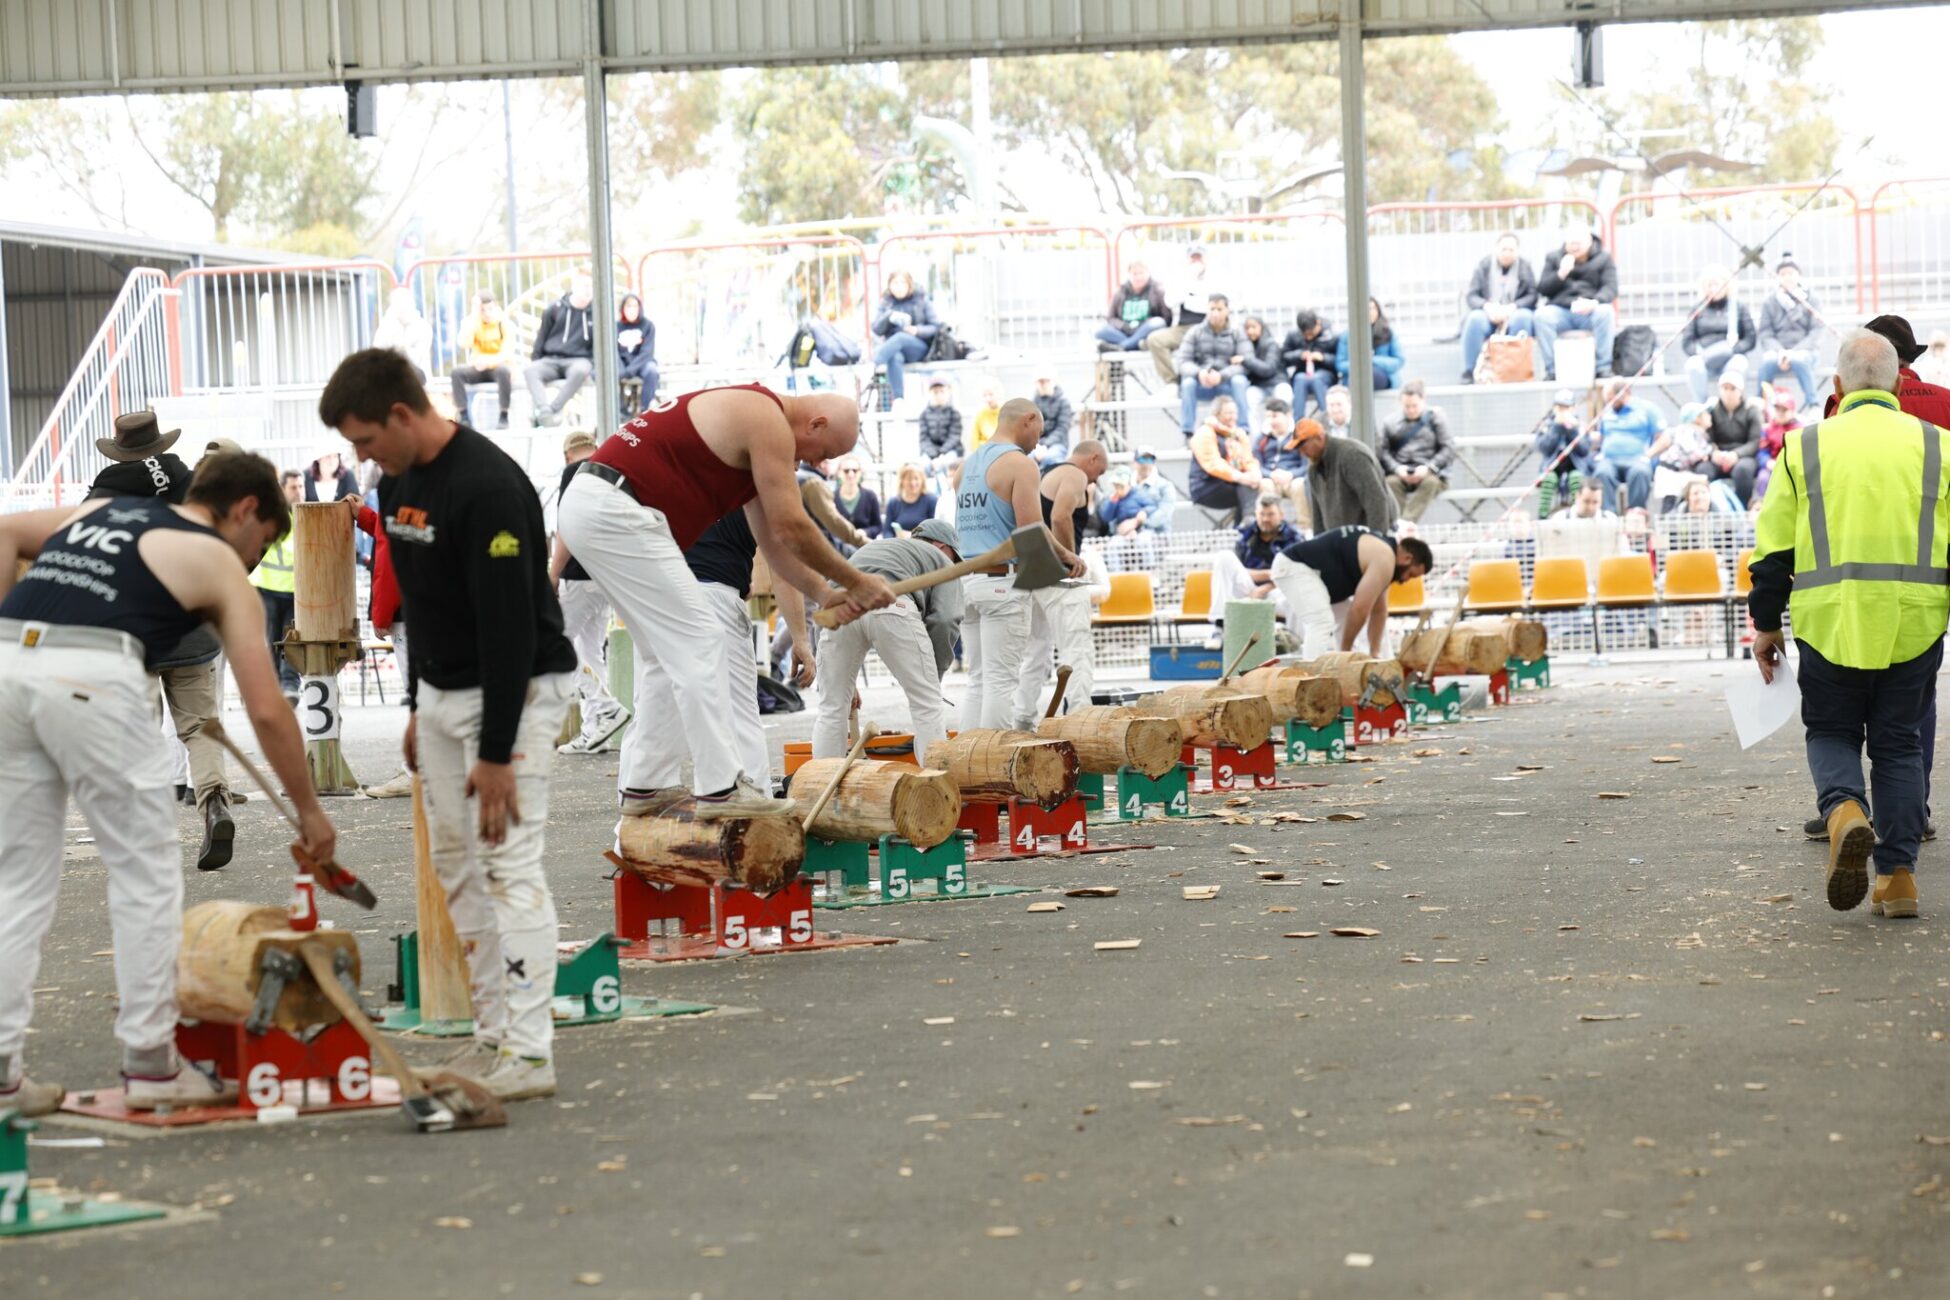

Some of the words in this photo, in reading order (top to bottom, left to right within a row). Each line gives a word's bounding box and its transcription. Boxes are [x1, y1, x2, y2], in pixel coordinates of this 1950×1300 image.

[957, 492, 988, 509] NSW
[65, 521, 135, 555] VIC
[304, 680, 334, 736] 3
[1414, 703, 1428, 721] 2
[1447, 701, 1460, 720] 2
[1358, 721, 1372, 741] 2
[1393, 718, 1407, 739] 2
[1292, 740, 1307, 761] 3
[1331, 738, 1345, 760] 3
[1218, 764, 1234, 788] 3
[1125, 793, 1143, 817] 4
[1170, 790, 1188, 813] 4
[1016, 824, 1036, 850] 4
[1067, 820, 1086, 846] 4
[888, 868, 909, 898] 5
[945, 864, 965, 893] 5
[723, 915, 748, 948] 5
[789, 909, 813, 943] 5
[591, 975, 620, 1013] 6
[247, 1062, 282, 1107] 6
[337, 1056, 372, 1100] 6
[0, 1171, 28, 1225] 7
